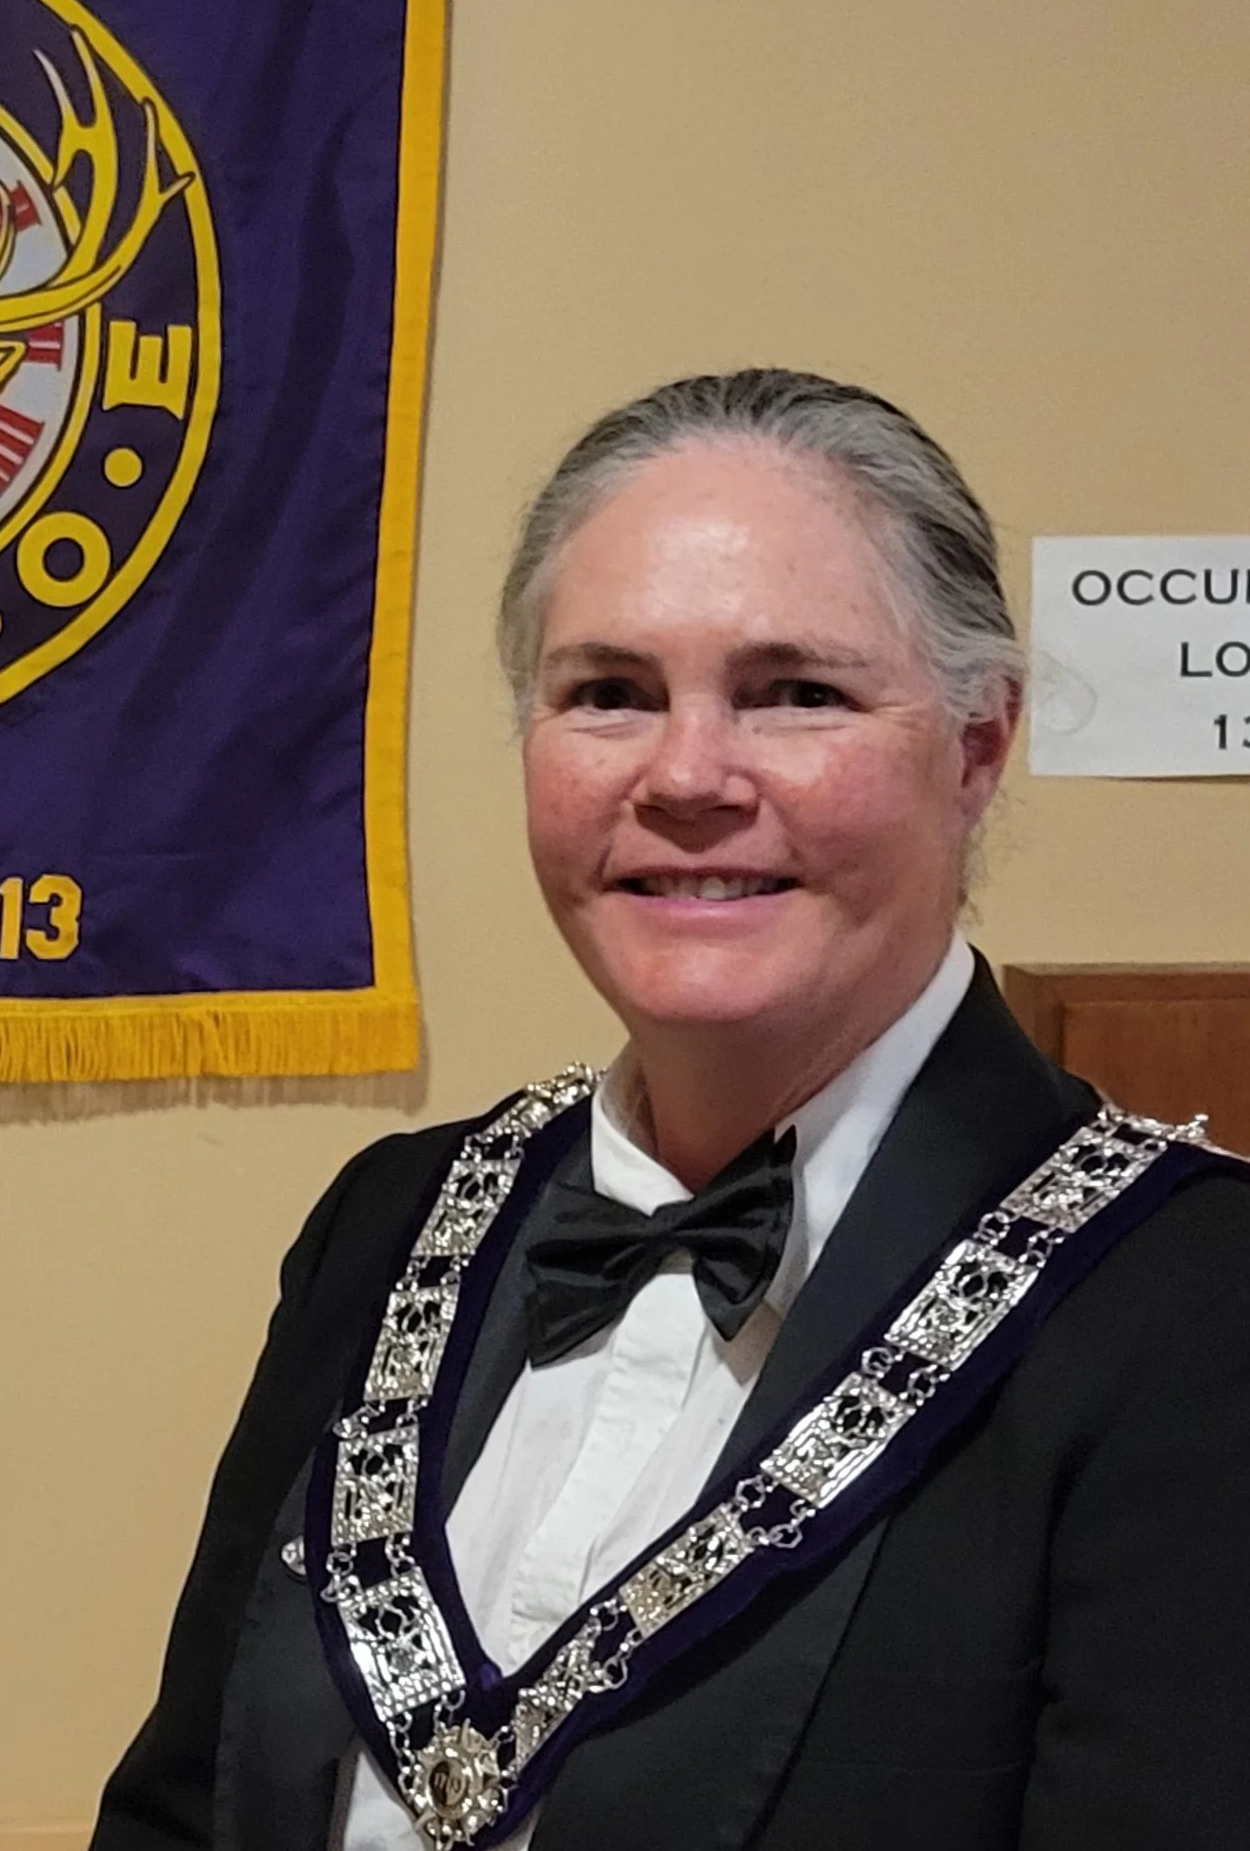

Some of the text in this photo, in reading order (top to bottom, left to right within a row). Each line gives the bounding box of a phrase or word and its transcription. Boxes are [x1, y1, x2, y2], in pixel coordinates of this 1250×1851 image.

[16, 511, 111, 608] O
[105, 321, 192, 419] E
[1072, 568, 1250, 606] OCCU
